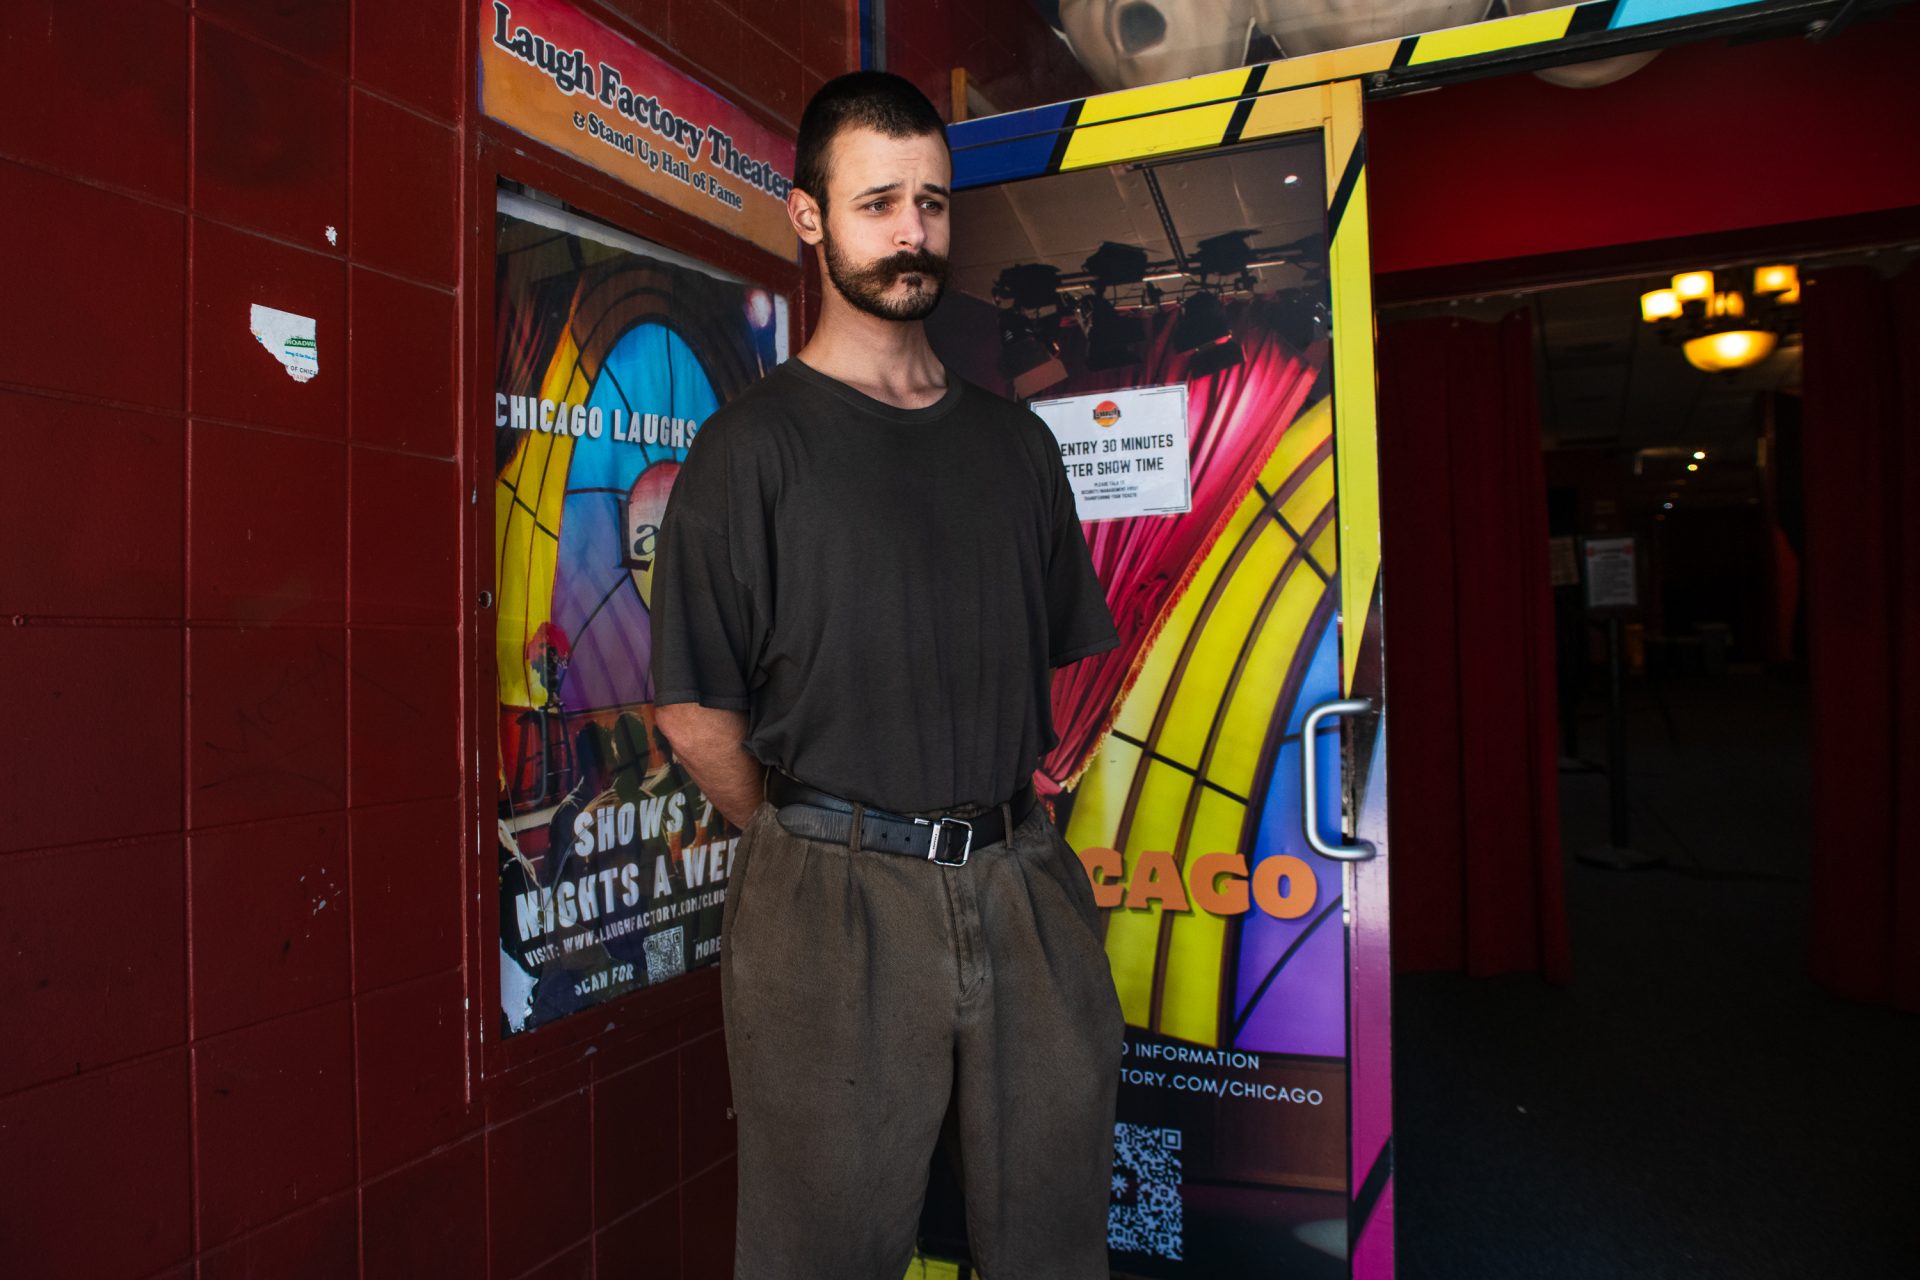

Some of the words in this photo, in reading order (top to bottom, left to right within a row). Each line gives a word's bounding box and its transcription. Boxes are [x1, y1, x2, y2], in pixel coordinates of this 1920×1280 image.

[493, 1, 596, 97] Laugh
[598, 62, 704, 161] Factory
[708, 125, 793, 203] Theater
[573, 111, 586, 130] &
[587, 112, 635, 156] Stand
[637, 138, 659, 171] Up
[662, 150, 690, 185] Hall
[693, 171, 707, 193] of
[709, 175, 743, 211] Fame
[496, 392, 603, 439] CHICAGO
[613, 409, 698, 449] LAUGHS
[1061, 440, 1098, 457] ENTRY
[1102, 438, 1117, 453] 30
[1121, 434, 1174, 451] MINUTES
[1097, 459, 1131, 476] SHOW
[1136, 457, 1165, 473] TIME
[574, 792, 686, 857] SHOWS
[515, 863, 640, 942] NIGHTS
[653, 854, 672, 899] A
[1078, 847, 1318, 920] CAGO
[524, 943, 560, 968] VISIT:
[695, 936, 721, 960] MORE
[574, 970, 608, 996] SCAN
[612, 963, 634, 984] FOR
[1135, 1043, 1260, 1070] INFORMATION
